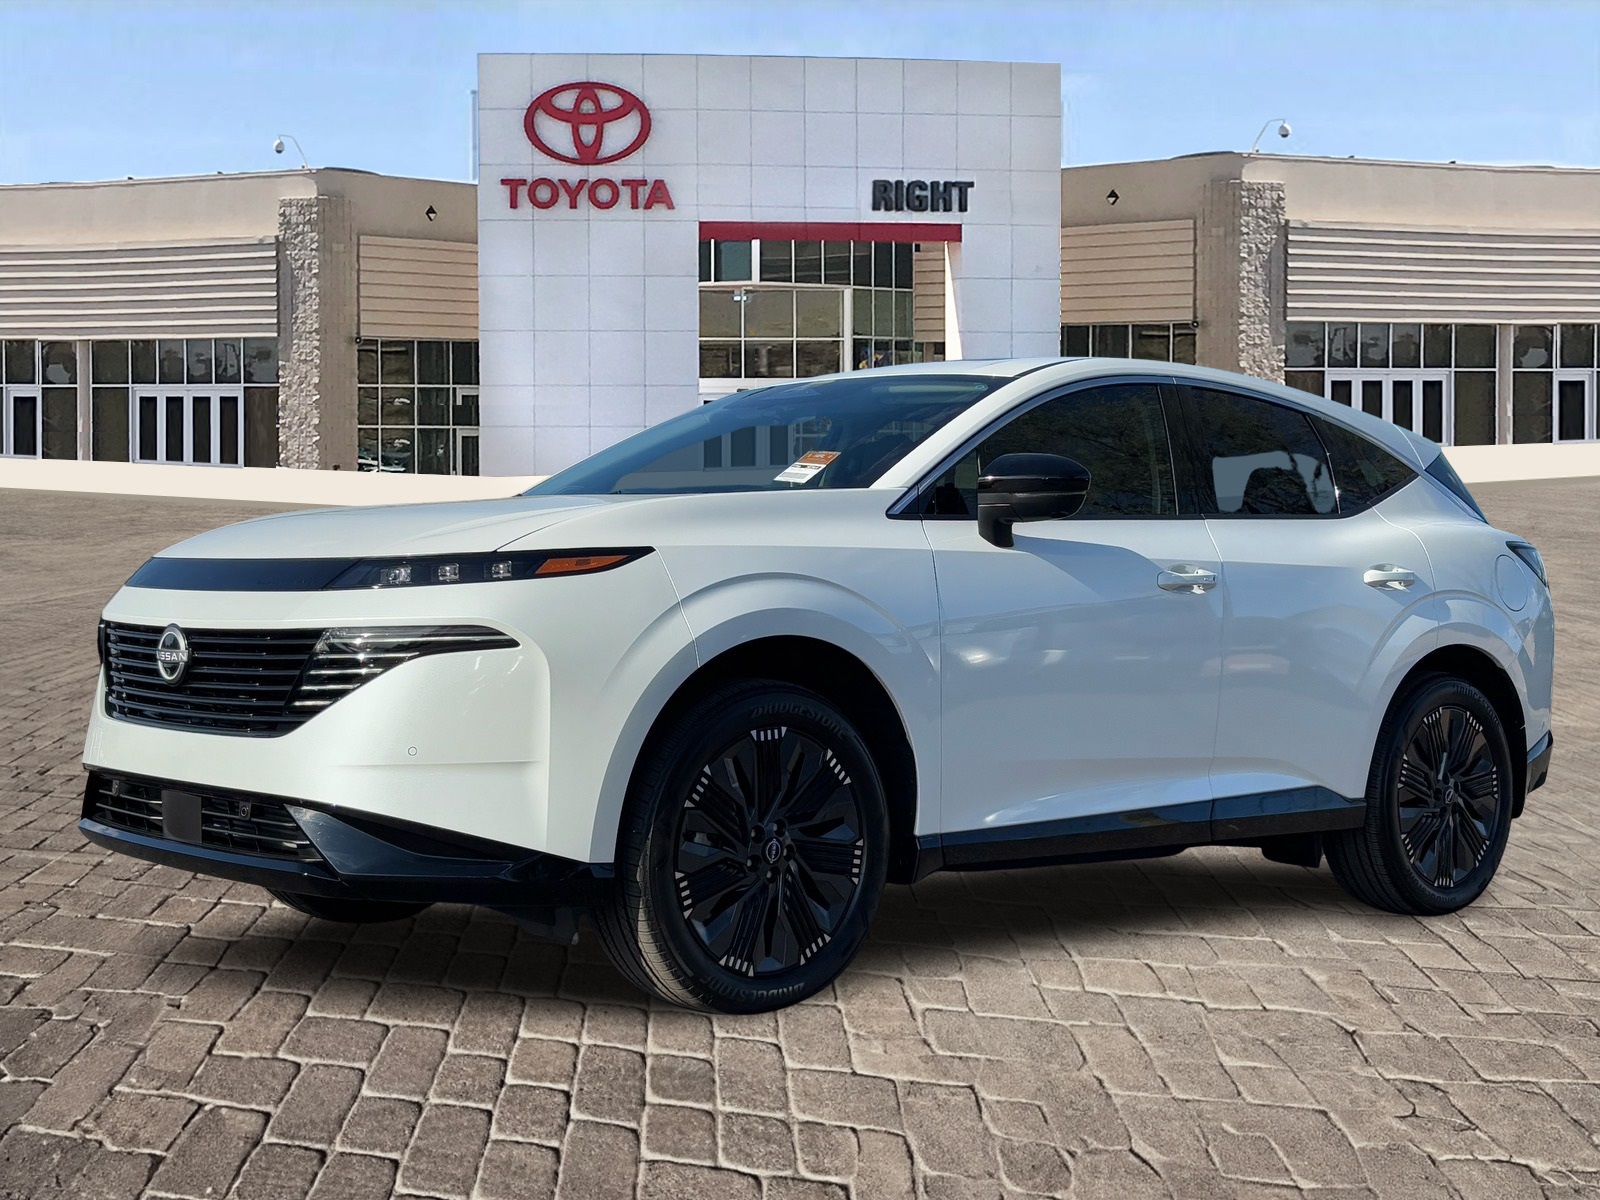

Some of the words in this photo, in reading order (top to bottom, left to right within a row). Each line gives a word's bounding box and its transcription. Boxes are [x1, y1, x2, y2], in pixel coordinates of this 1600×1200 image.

[501, 178, 674, 210] TOYOTA
[872, 180, 974, 212] RIGHT
[750, 703, 846, 740] BRIDGESTONE
